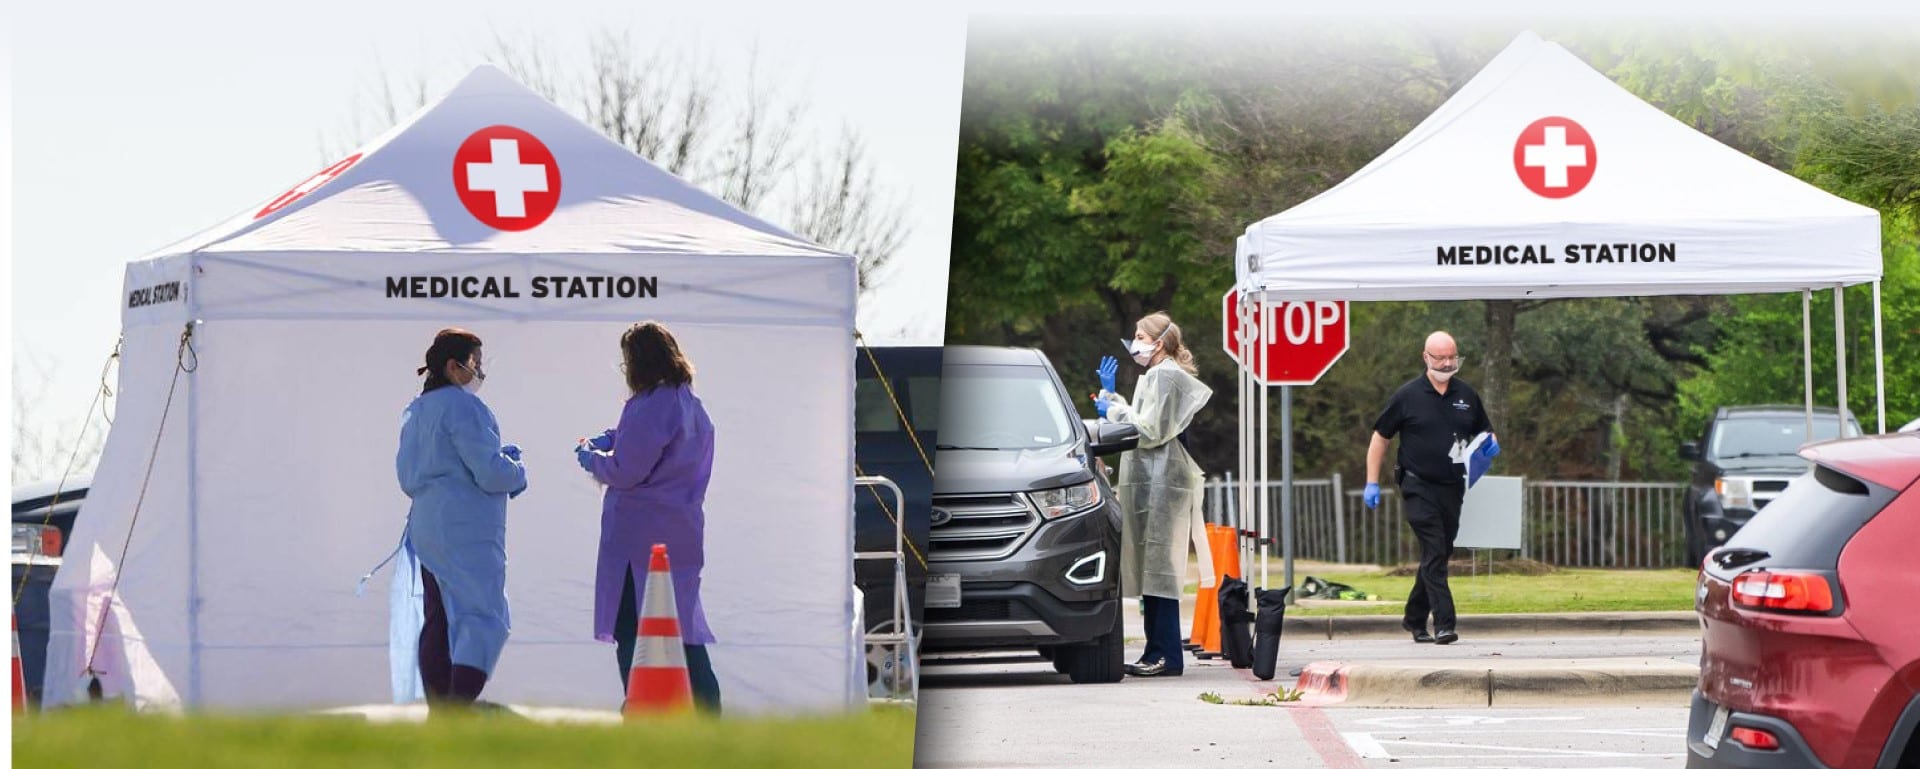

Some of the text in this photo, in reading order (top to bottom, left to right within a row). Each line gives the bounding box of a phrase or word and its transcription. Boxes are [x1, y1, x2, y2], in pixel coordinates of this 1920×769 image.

[1437, 243, 1676, 266] MEDICAL STATION
[386, 276, 658, 299] MEDICAL STATION
